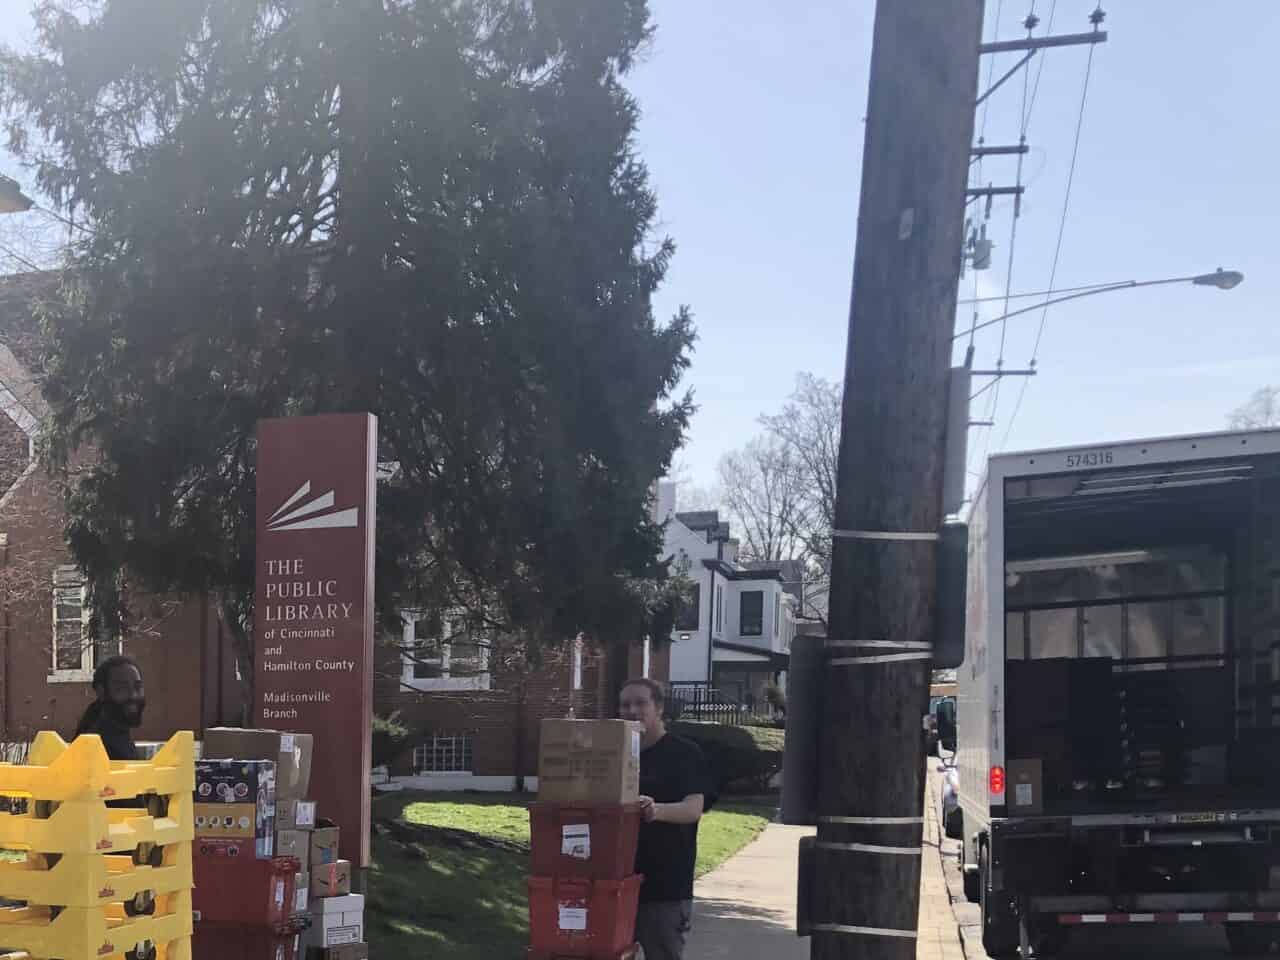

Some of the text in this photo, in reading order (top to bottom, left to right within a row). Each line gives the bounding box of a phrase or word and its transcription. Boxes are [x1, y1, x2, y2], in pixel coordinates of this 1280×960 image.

[1066, 451, 1113, 467] 574316
[264, 559, 304, 576] THE
[266, 580, 337, 599] PUBLIC
[265, 602, 353, 621] LIBRARY
[264, 626, 335, 640] of Cincinnati
[264, 645, 282, 656] and
[264, 659, 355, 672] Hamilton County
[263, 692, 331, 703] Madisonville
[263, 708, 298, 719] Branch
